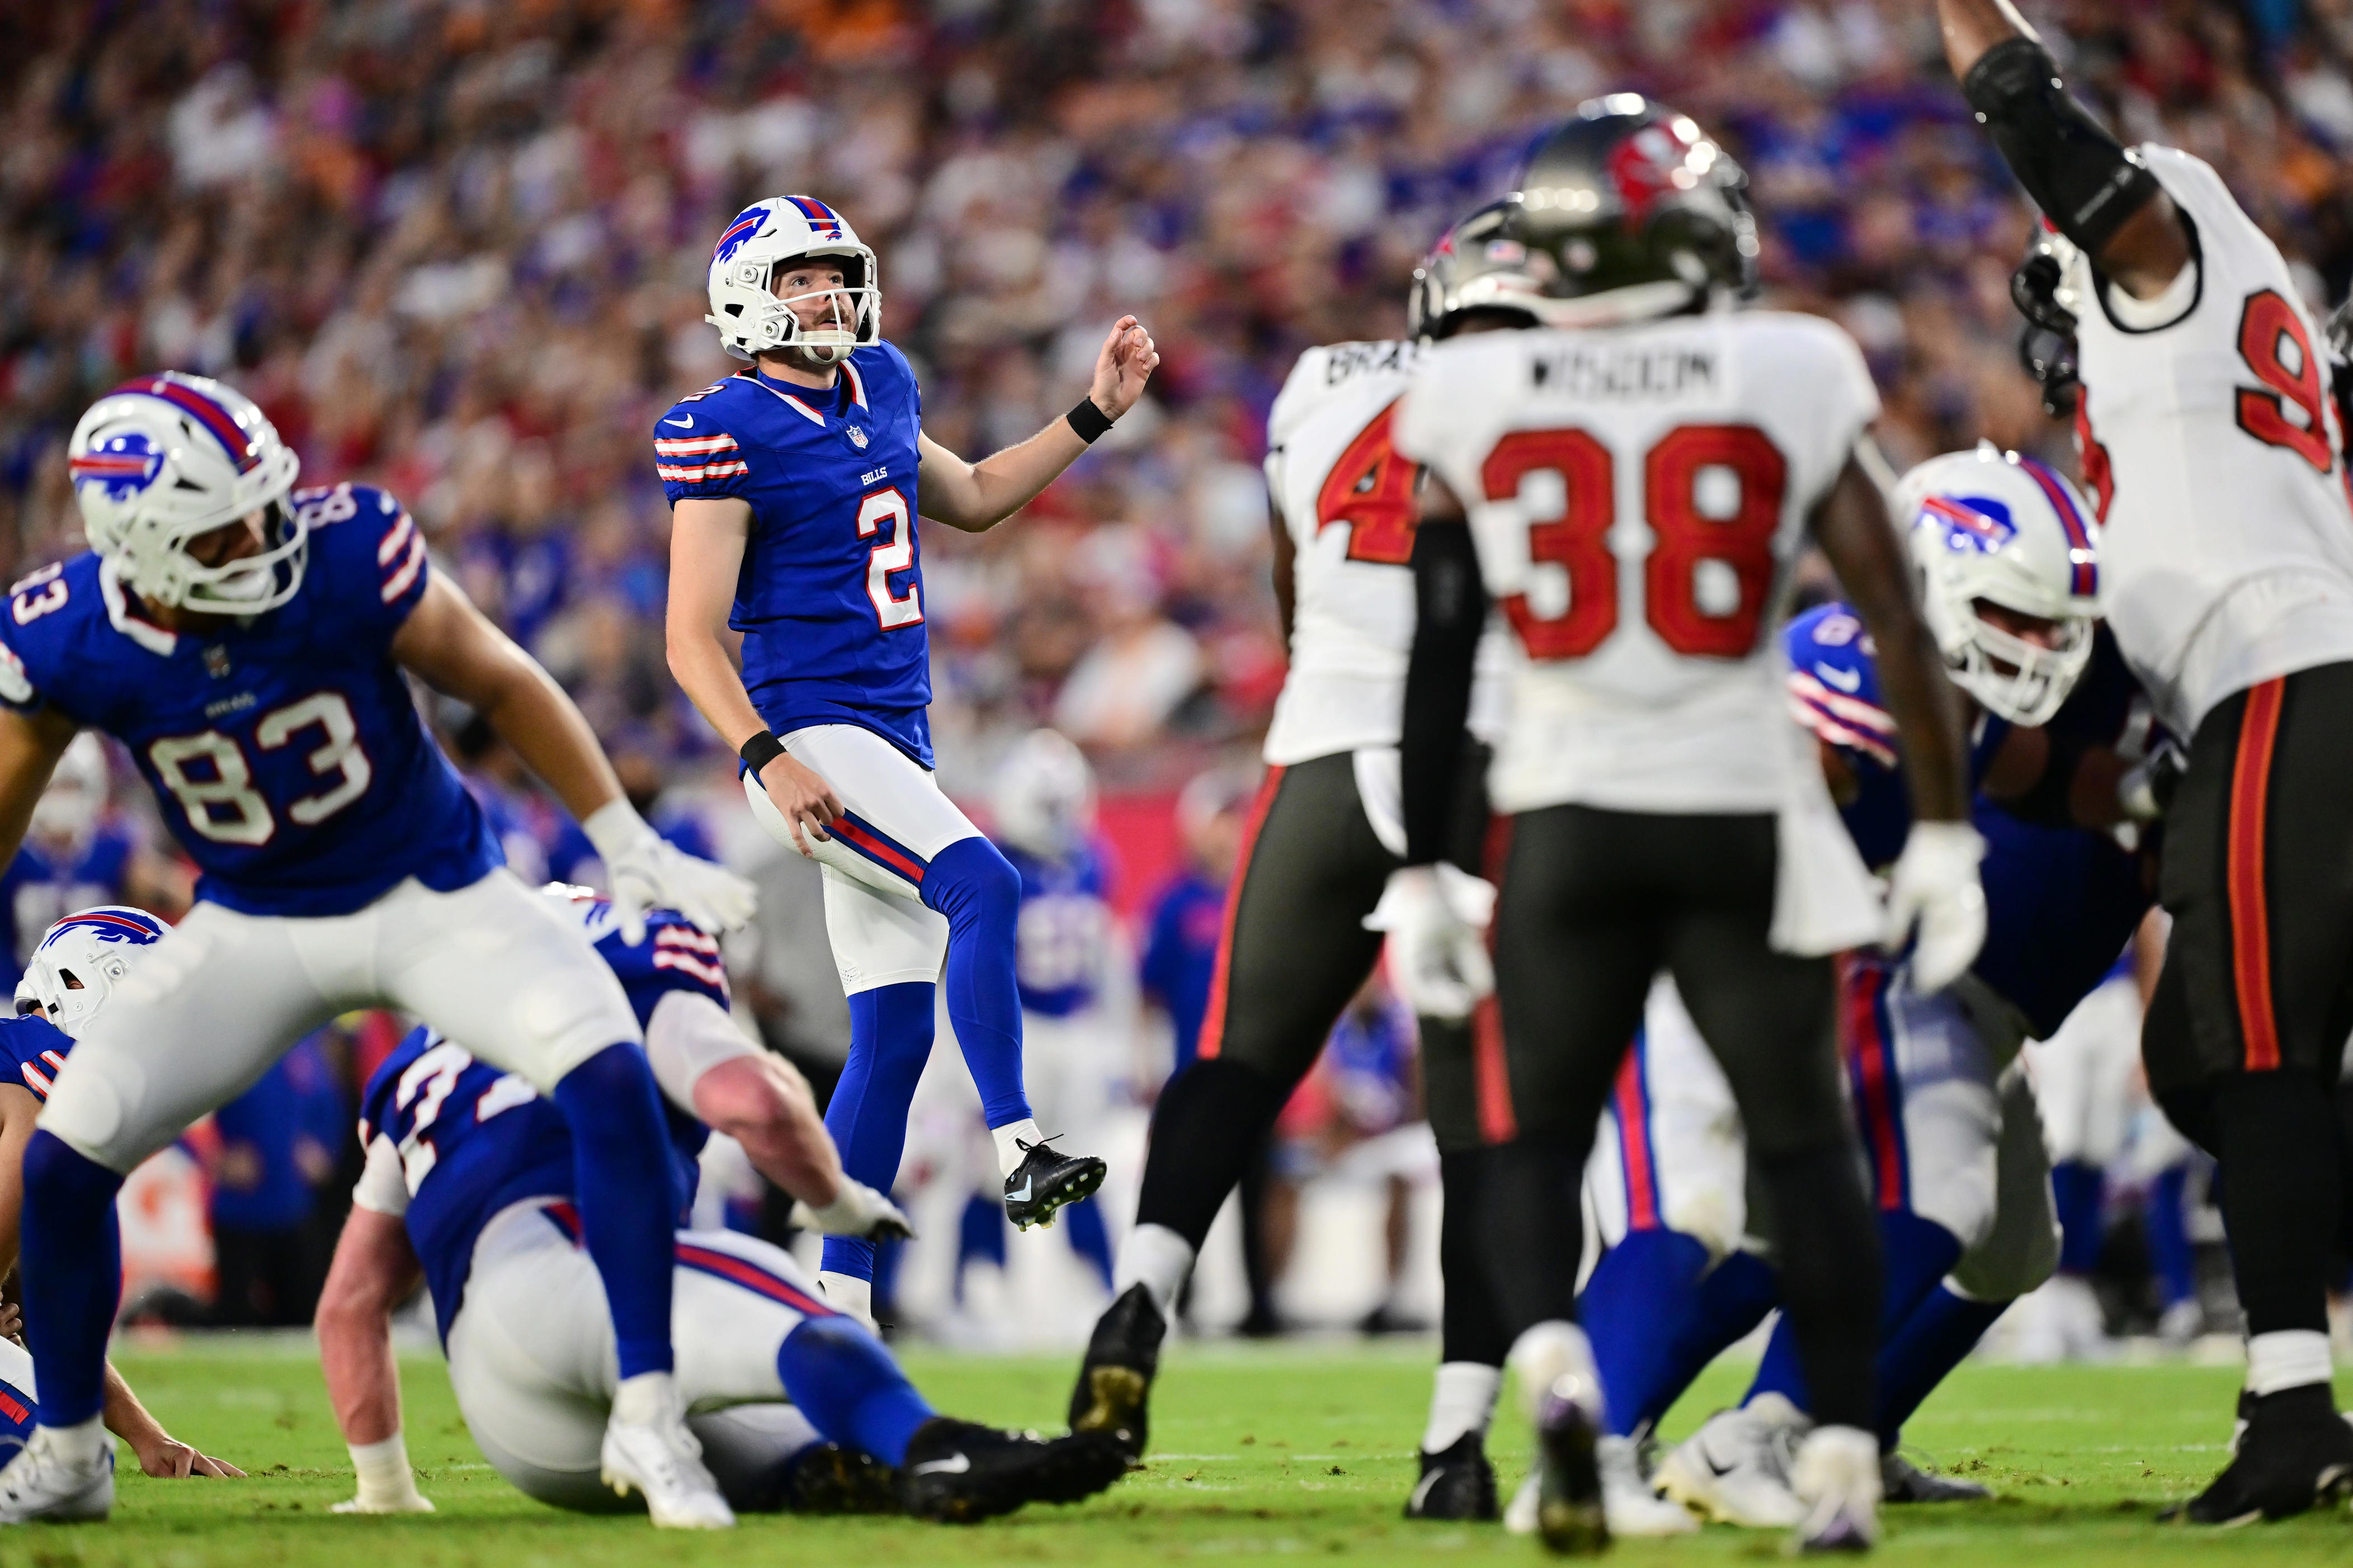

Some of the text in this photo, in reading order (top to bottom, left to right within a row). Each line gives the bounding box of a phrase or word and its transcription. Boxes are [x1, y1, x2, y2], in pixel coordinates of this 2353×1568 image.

[860, 466, 888, 486] BILLS
[1480, 422, 1786, 662] 38
[856, 485, 925, 632] 2
[149, 691, 372, 847] 83
